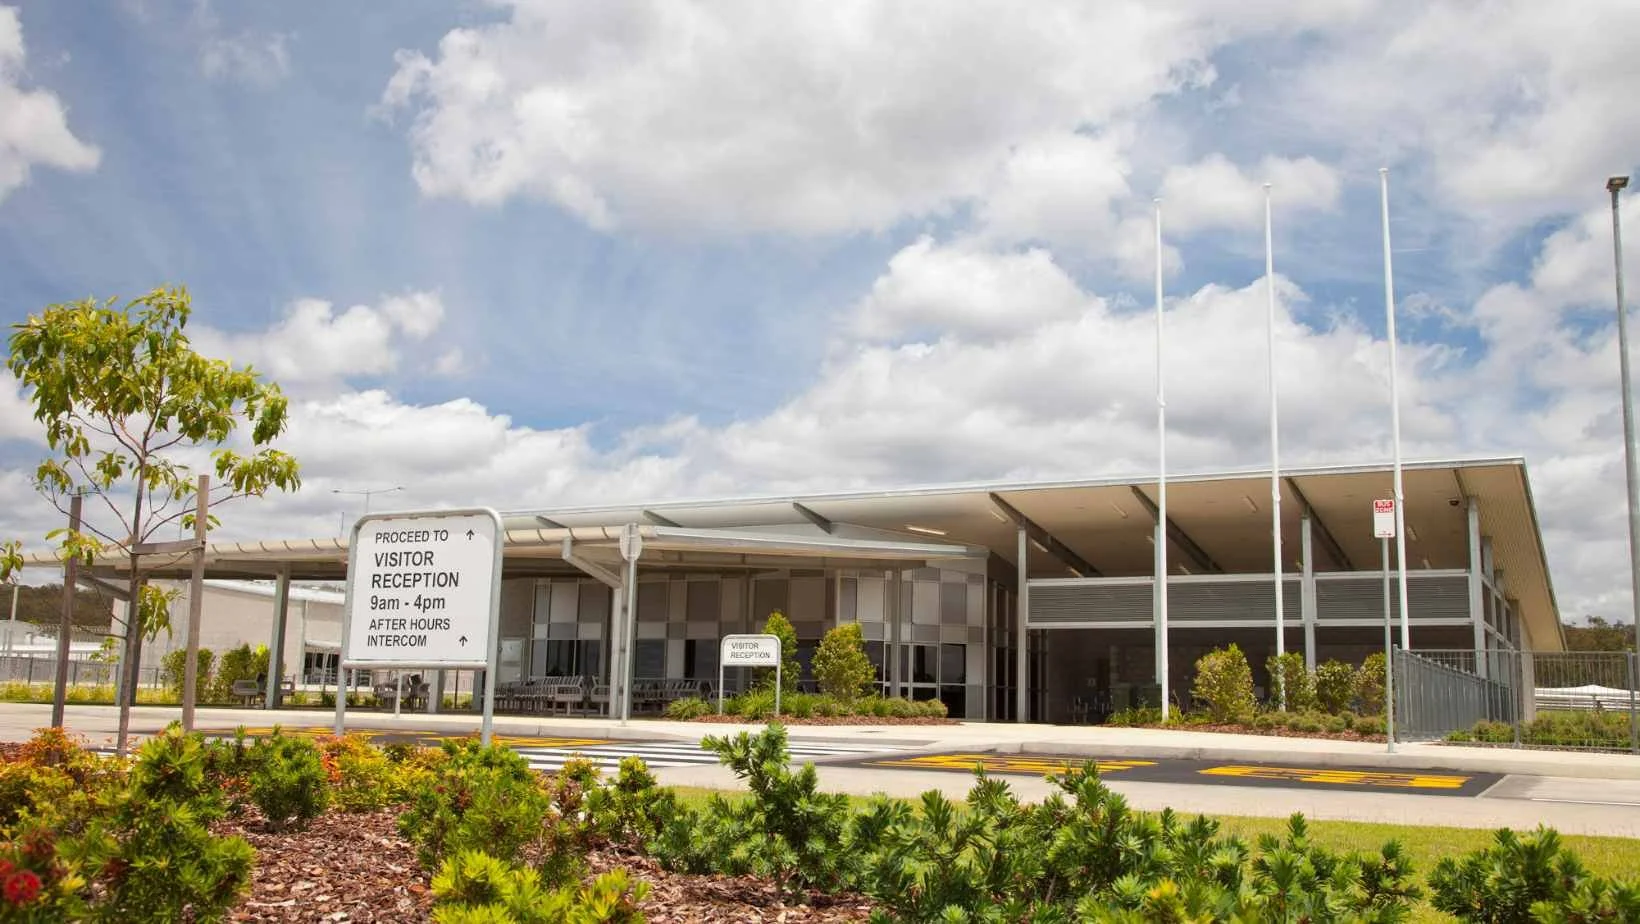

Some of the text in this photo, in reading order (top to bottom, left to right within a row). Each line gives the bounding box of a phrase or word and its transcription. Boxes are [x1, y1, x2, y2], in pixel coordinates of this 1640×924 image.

[375, 529, 449, 544] PROCEED TO
[374, 551, 434, 567] VISITOR
[371, 572, 459, 588] RECEPTION
[370, 595, 400, 610] 9am
[413, 594, 446, 613] 4pm
[369, 618, 451, 631] AFTER HOURS
[367, 635, 427, 647] INTERCOM
[731, 642, 759, 650] VISITOR
[730, 651, 771, 659] RECEPTION
